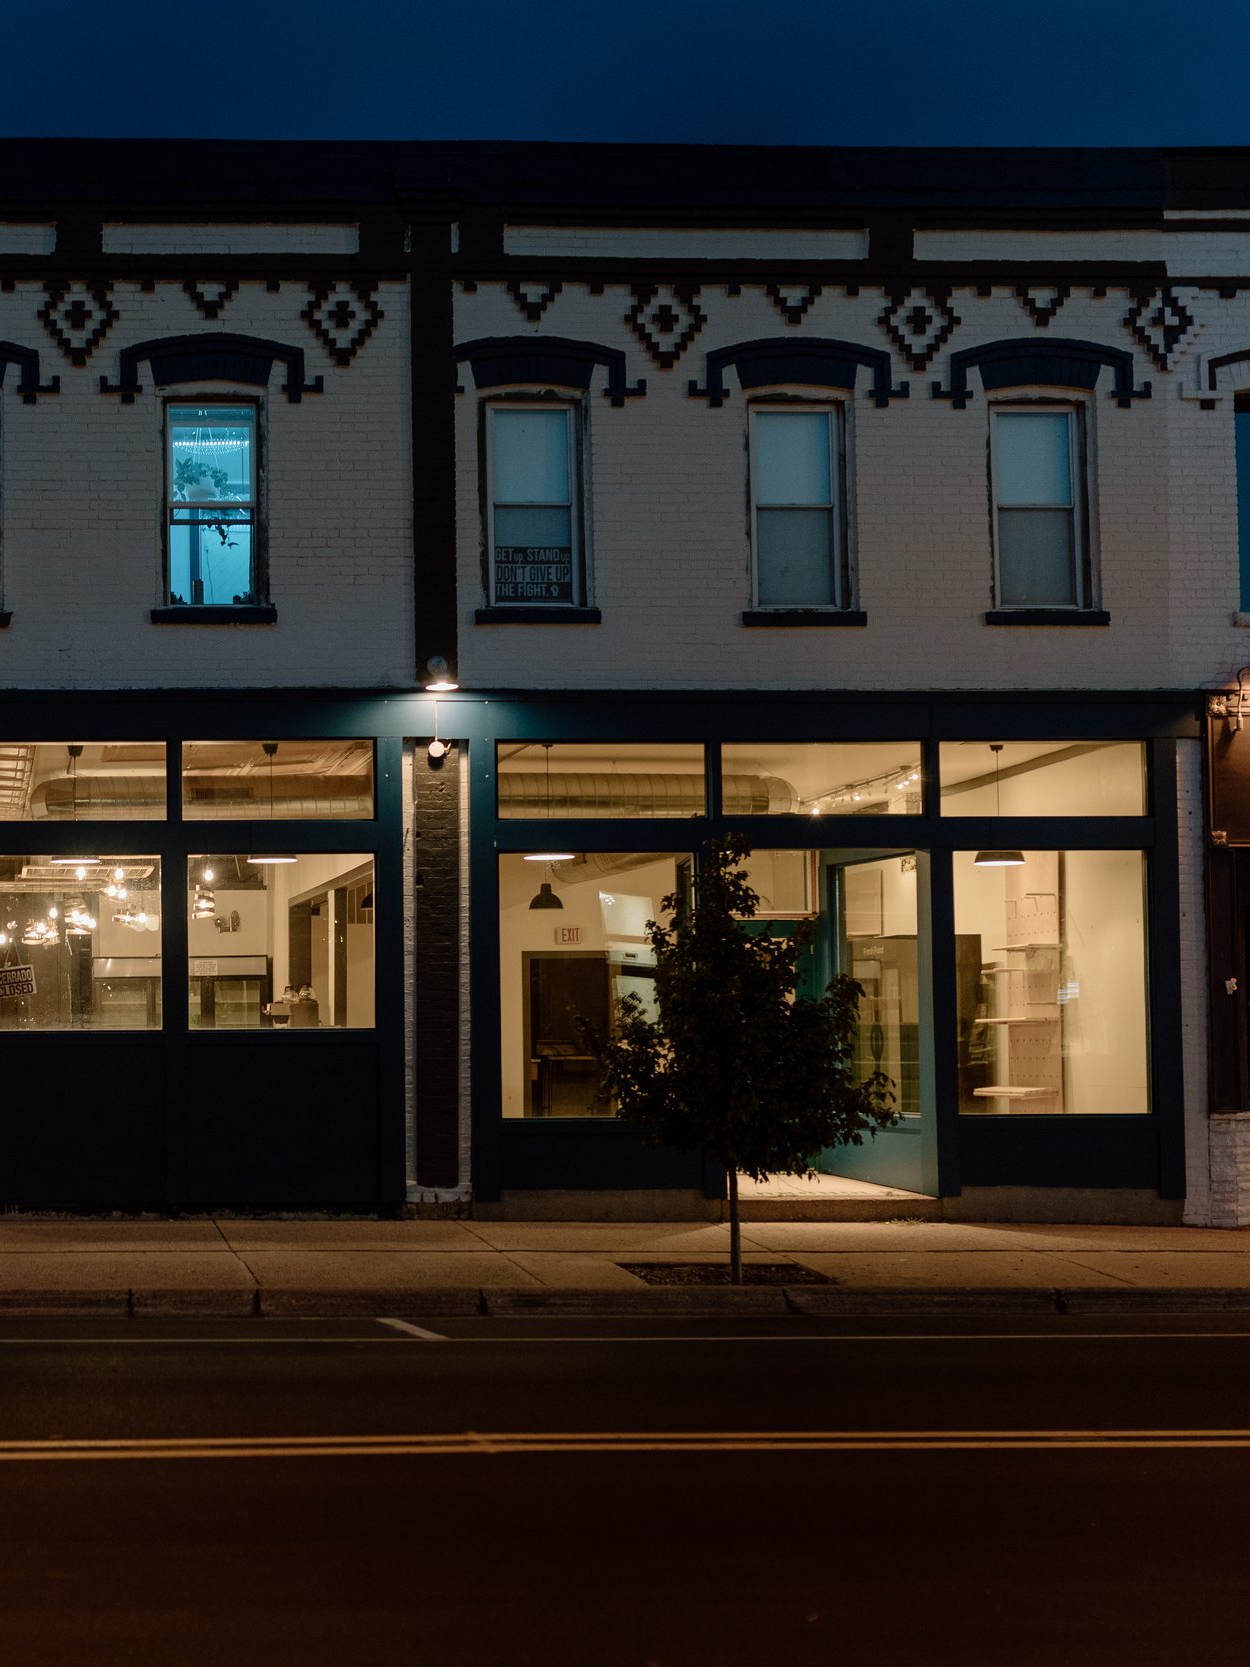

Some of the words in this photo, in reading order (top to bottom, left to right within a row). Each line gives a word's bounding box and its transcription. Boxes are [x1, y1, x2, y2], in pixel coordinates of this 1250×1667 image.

[495, 548, 514, 561] GET
[526, 548, 559, 561] STAND
[496, 566, 526, 581] DON'T
[529, 566, 552, 581] GIVE
[555, 566, 569, 581] UP
[495, 583, 515, 596] THE
[561, 928, 580, 942] EXIT
